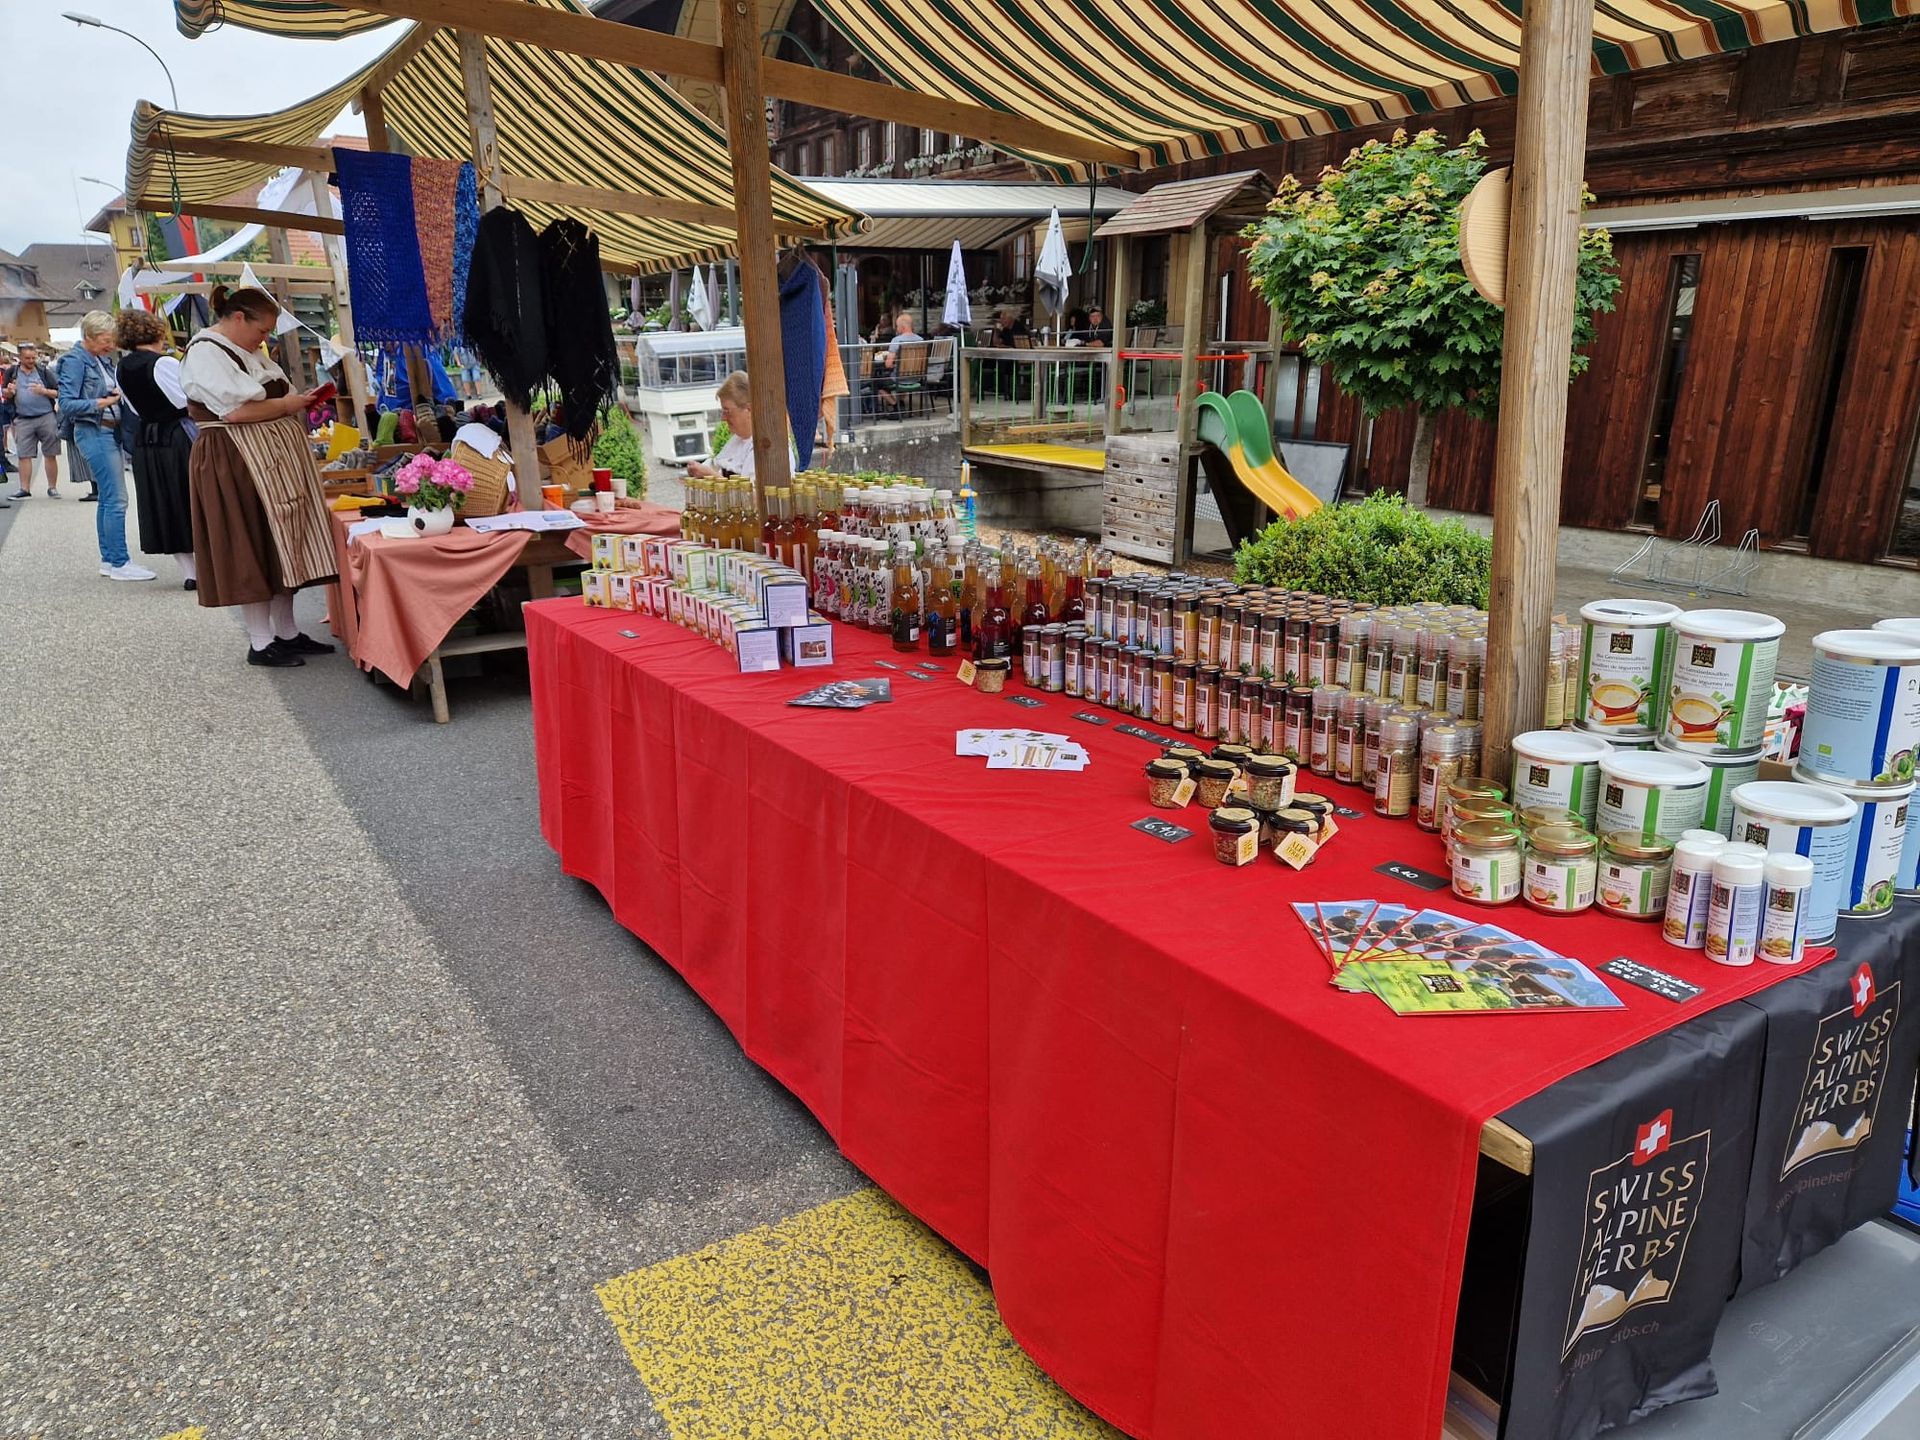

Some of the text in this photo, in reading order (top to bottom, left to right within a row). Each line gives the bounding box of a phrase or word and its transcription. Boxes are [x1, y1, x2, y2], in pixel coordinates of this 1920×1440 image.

[1816, 1008, 1893, 1065] SWISS
[1799, 1070, 1877, 1126] HERBS
[1807, 1040, 1884, 1096] ALPINE
[1592, 1160, 1697, 1224] SWISS
[1585, 1196, 1688, 1263] ALPINE
[1580, 1231, 1681, 1297] HERBS
